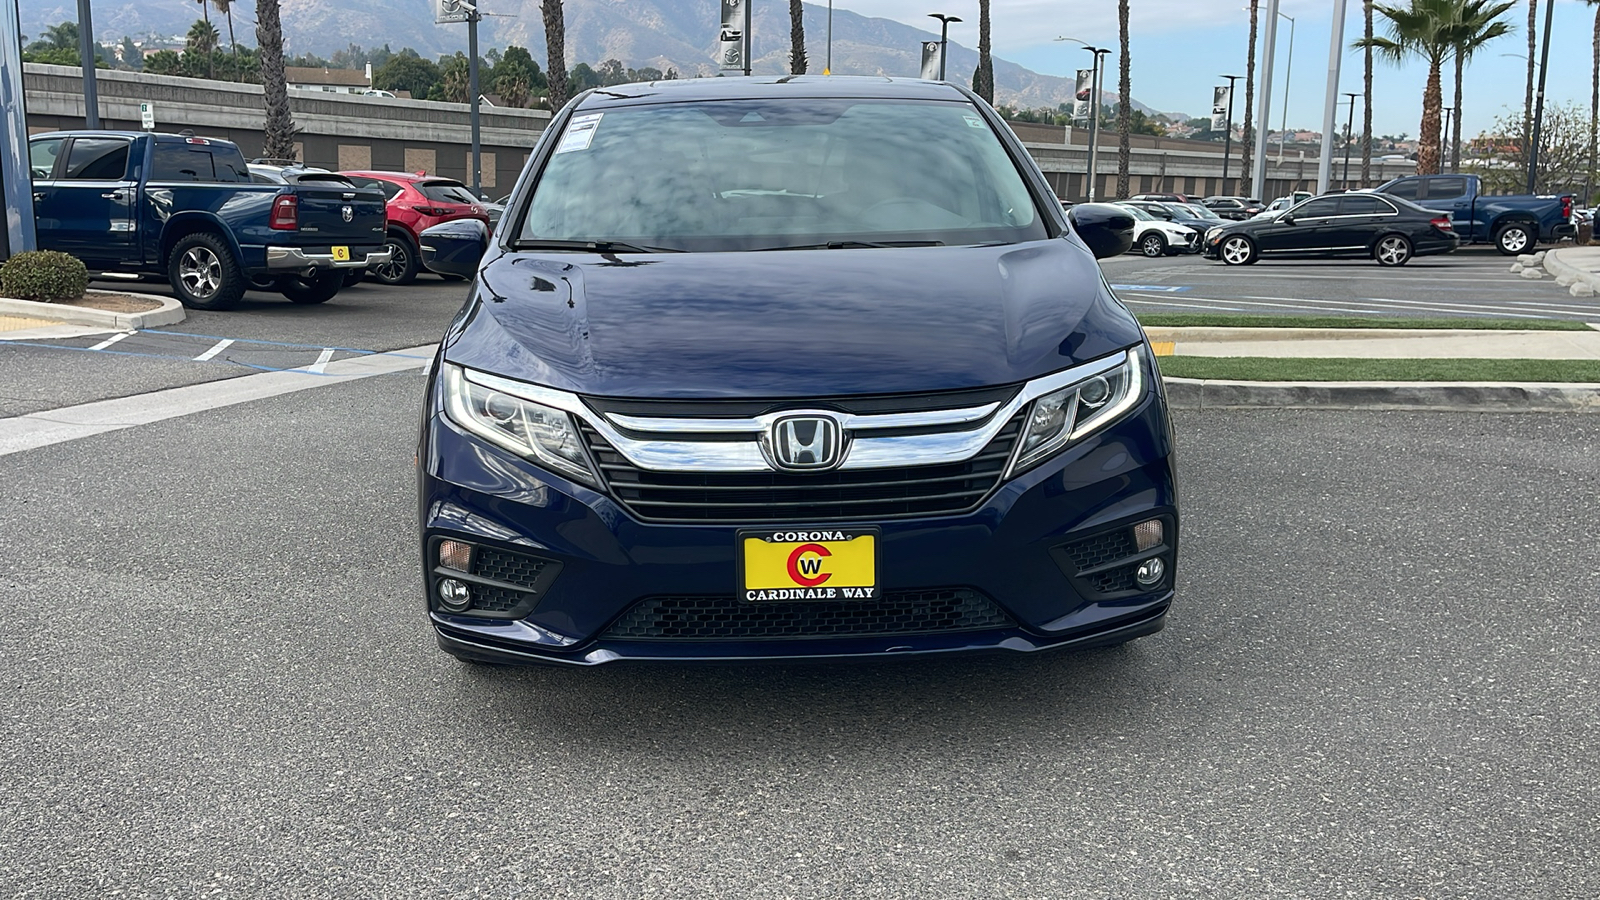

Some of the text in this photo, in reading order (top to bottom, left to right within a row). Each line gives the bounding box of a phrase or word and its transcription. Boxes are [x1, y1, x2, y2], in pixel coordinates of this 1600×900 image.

[773, 531, 846, 542] CORONA
[746, 587, 875, 601] CARDINALE WAY
